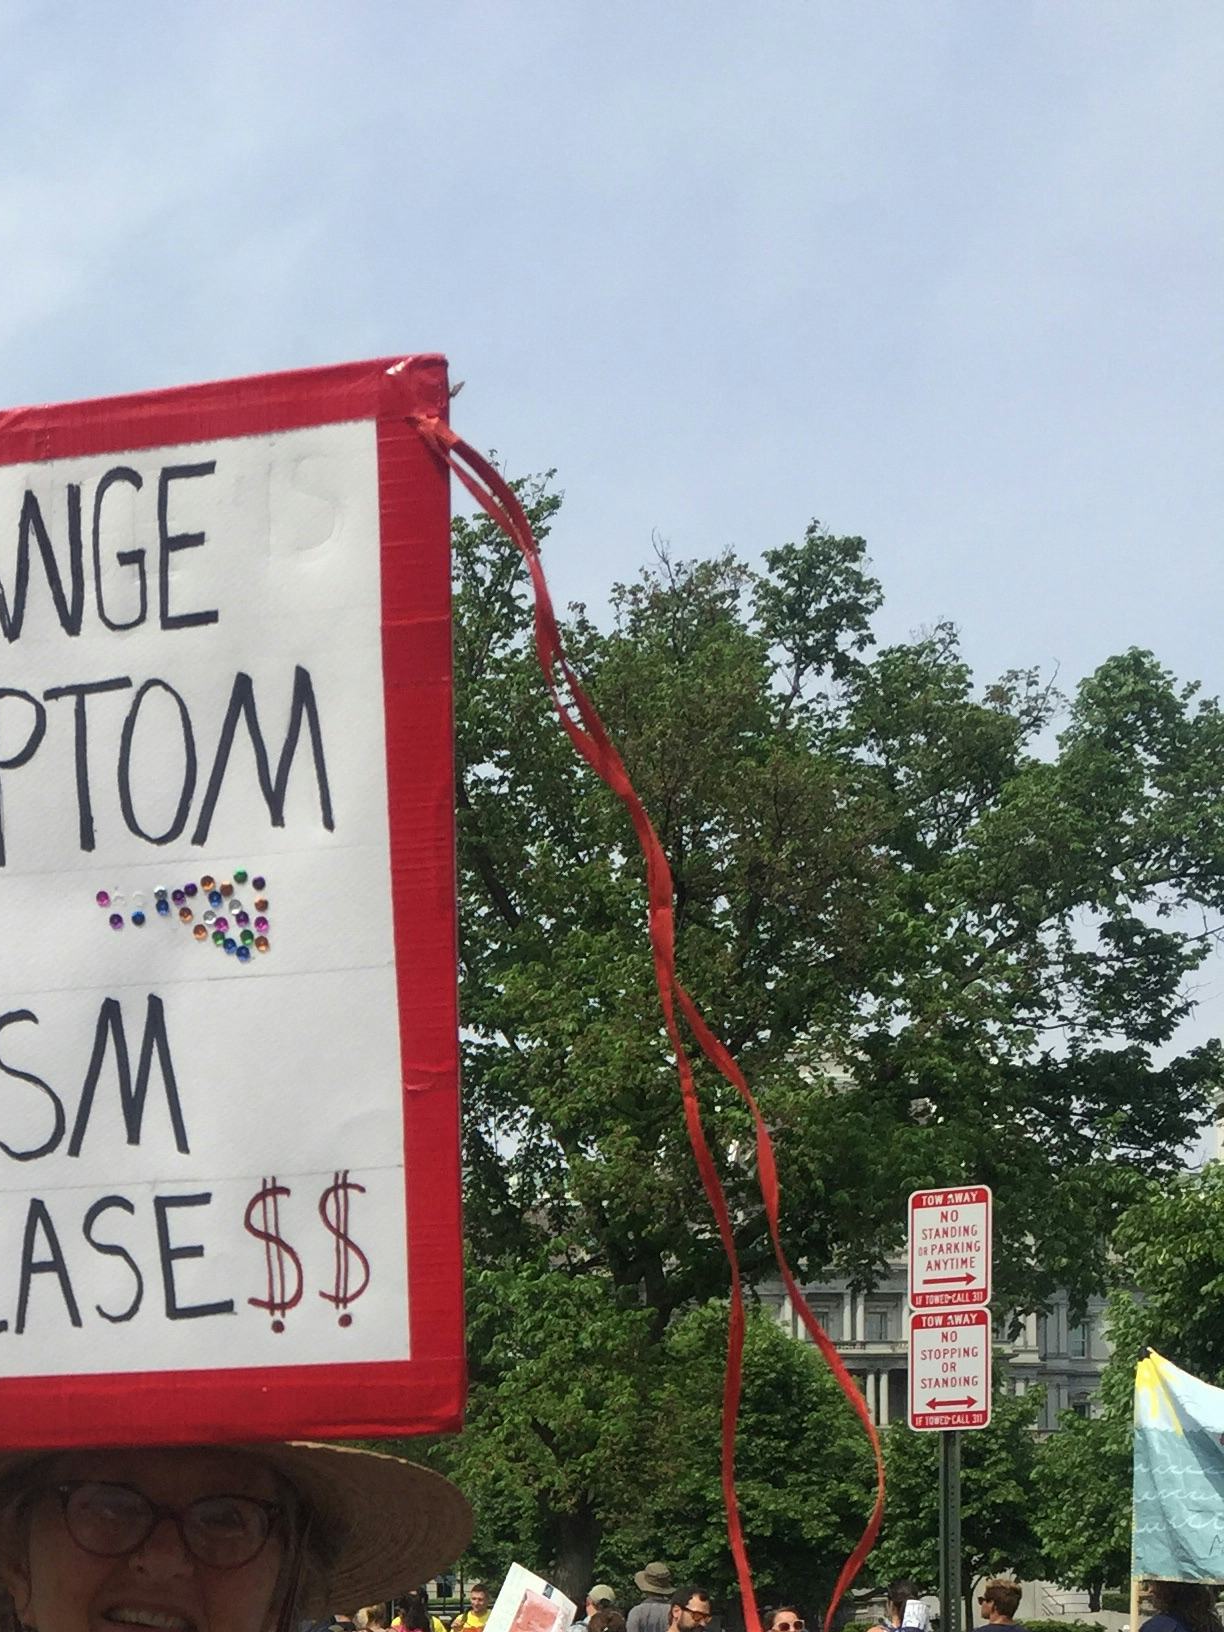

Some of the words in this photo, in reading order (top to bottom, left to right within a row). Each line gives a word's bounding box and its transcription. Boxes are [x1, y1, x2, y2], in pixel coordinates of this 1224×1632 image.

[921, 1194, 943, 1206] TOW
[947, 1191, 978, 1204] AWAY
[939, 1210, 959, 1223] NO
[921, 1224, 978, 1241] STANDING
[918, 1247, 928, 1257] OR
[930, 1241, 981, 1256] PARKING
[925, 1256, 977, 1272] ANYTIME
[973, 1291, 984, 1302] 311
[921, 1316, 943, 1327] TOW
[947, 1313, 978, 1326] AWAY
[940, 1330, 958, 1343] NO
[920, 1346, 979, 1361] STOPPING
[941, 1362, 957, 1373] OR
[920, 1375, 979, 1390] STANDING
[973, 1412, 984, 1424] 311
